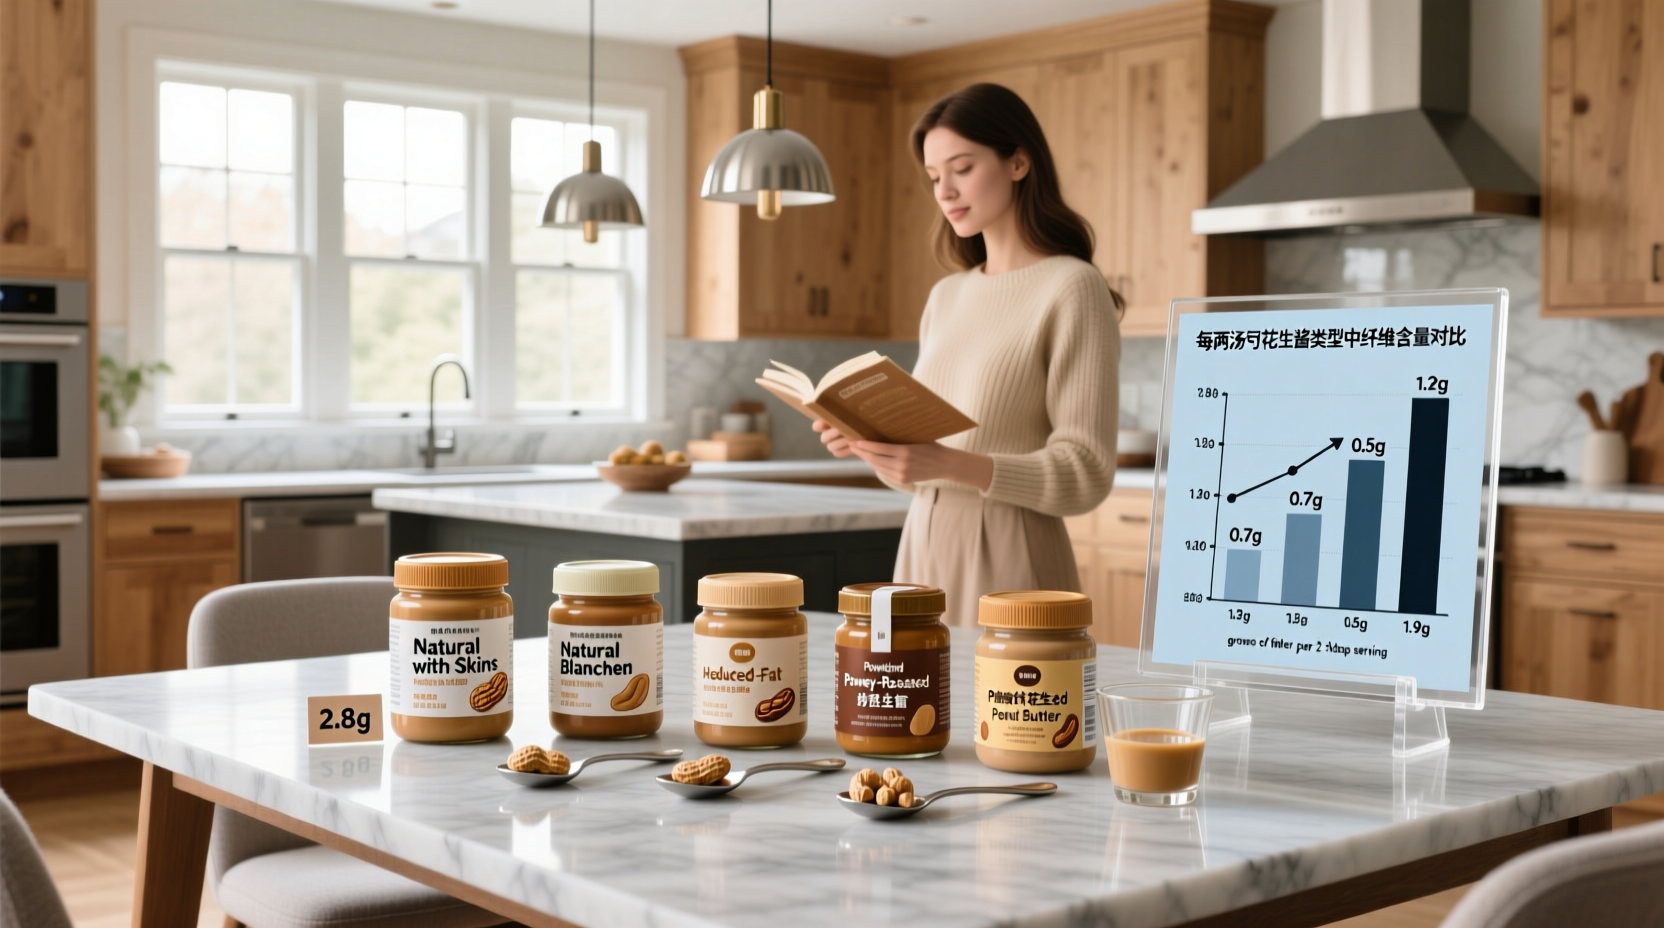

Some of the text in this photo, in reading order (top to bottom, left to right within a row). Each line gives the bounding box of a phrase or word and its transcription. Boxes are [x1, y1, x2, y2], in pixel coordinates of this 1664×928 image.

[1416, 375, 1449, 395] 1.2g
[1351, 437, 1386, 457] 0.5g
[1289, 491, 1323, 511] 0.7g
[1229, 527, 1262, 547] 0.7g
[1403, 620, 1431, 638] 1.9g
[413, 637, 480, 655] Natural
[561, 641, 620, 658] Natural
[412, 656, 498, 674] with Skins
[560, 659, 633, 676] Blanchen
[319, 707, 371, 735] 2.8g
